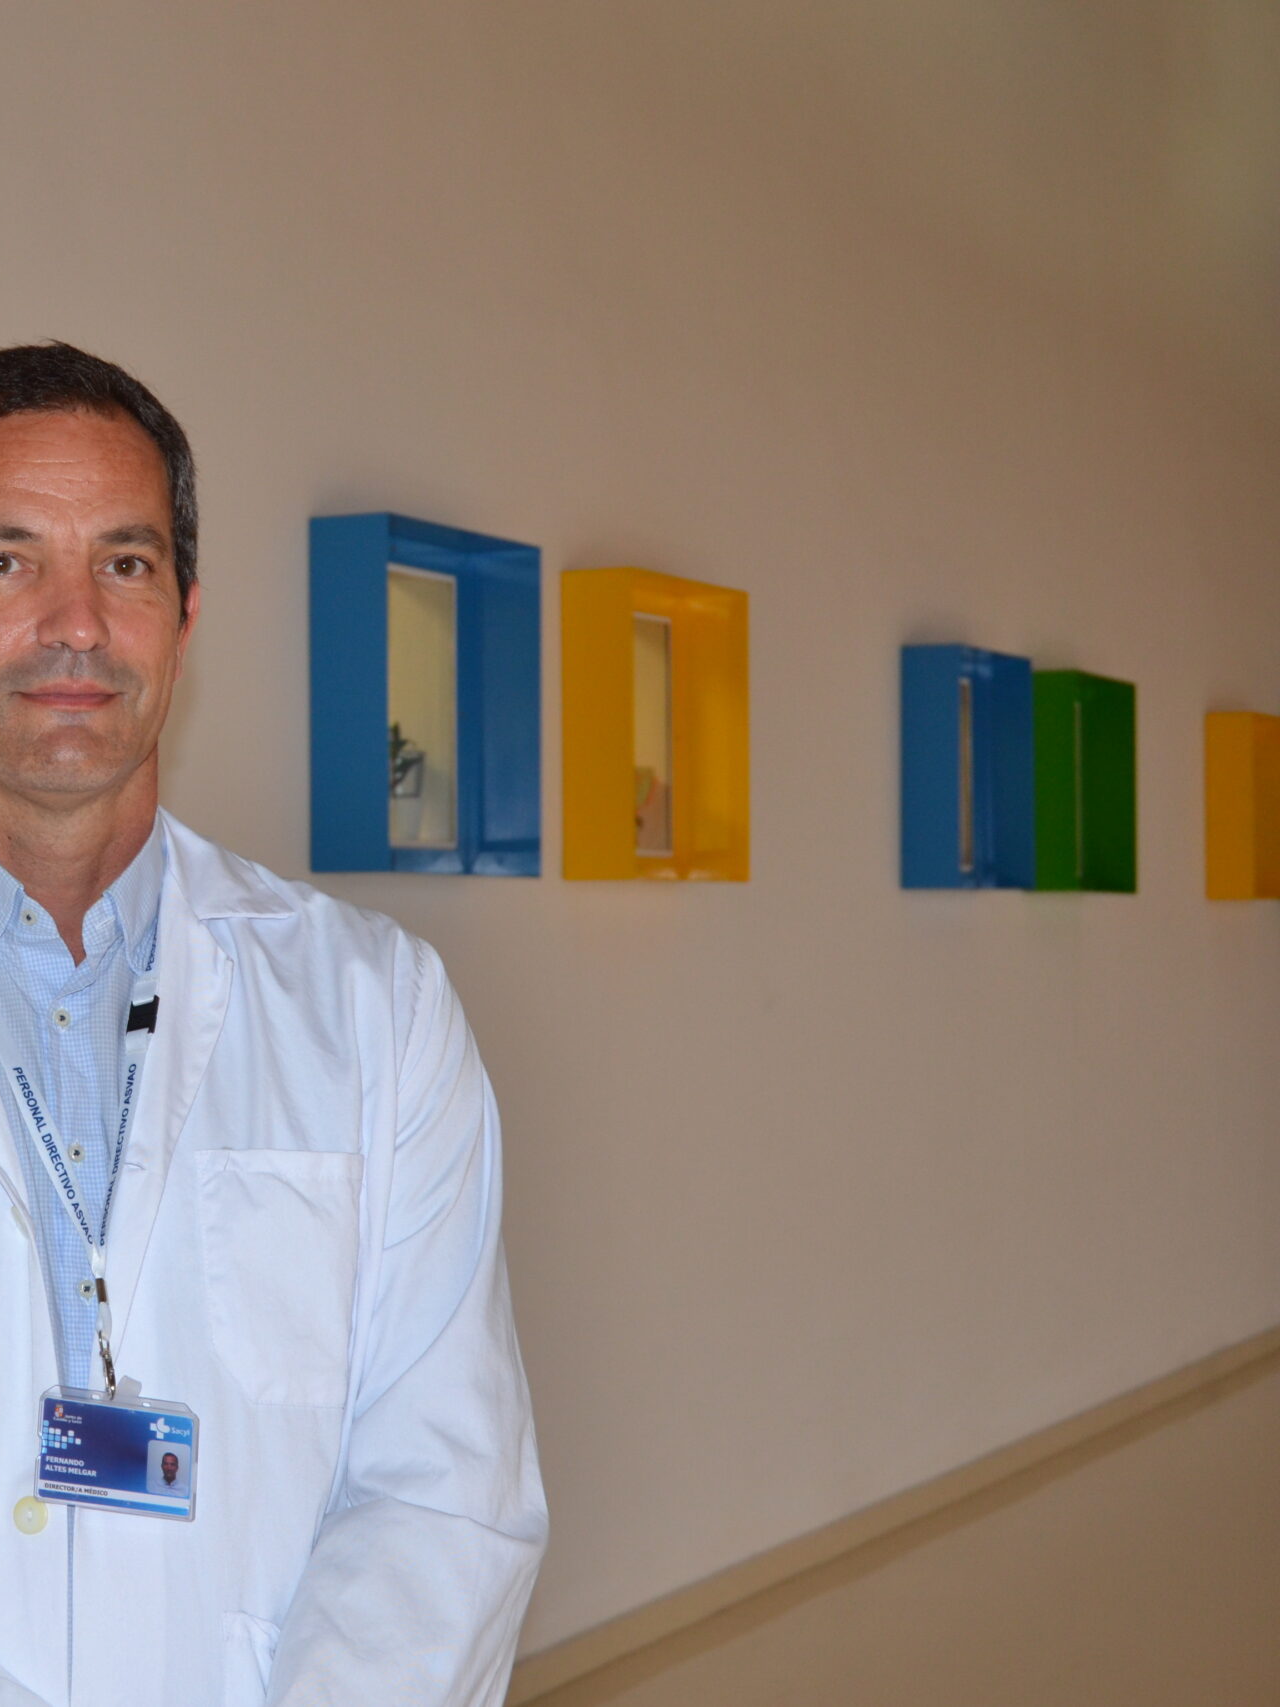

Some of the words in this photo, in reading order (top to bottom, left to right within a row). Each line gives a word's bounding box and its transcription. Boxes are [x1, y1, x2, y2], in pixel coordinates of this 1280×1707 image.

[13, 1066, 47, 1133] PERSONAL
[41, 1132, 76, 1200] DIRECTIVO
[112, 1108, 129, 1175] DIRECTIVO
[124, 1063, 137, 1104] ASVAO
[44, 1464, 67, 1473] ALTES
[67, 1466, 97, 1477] MELGAR
[45, 1455, 85, 1467] FERNANDO
